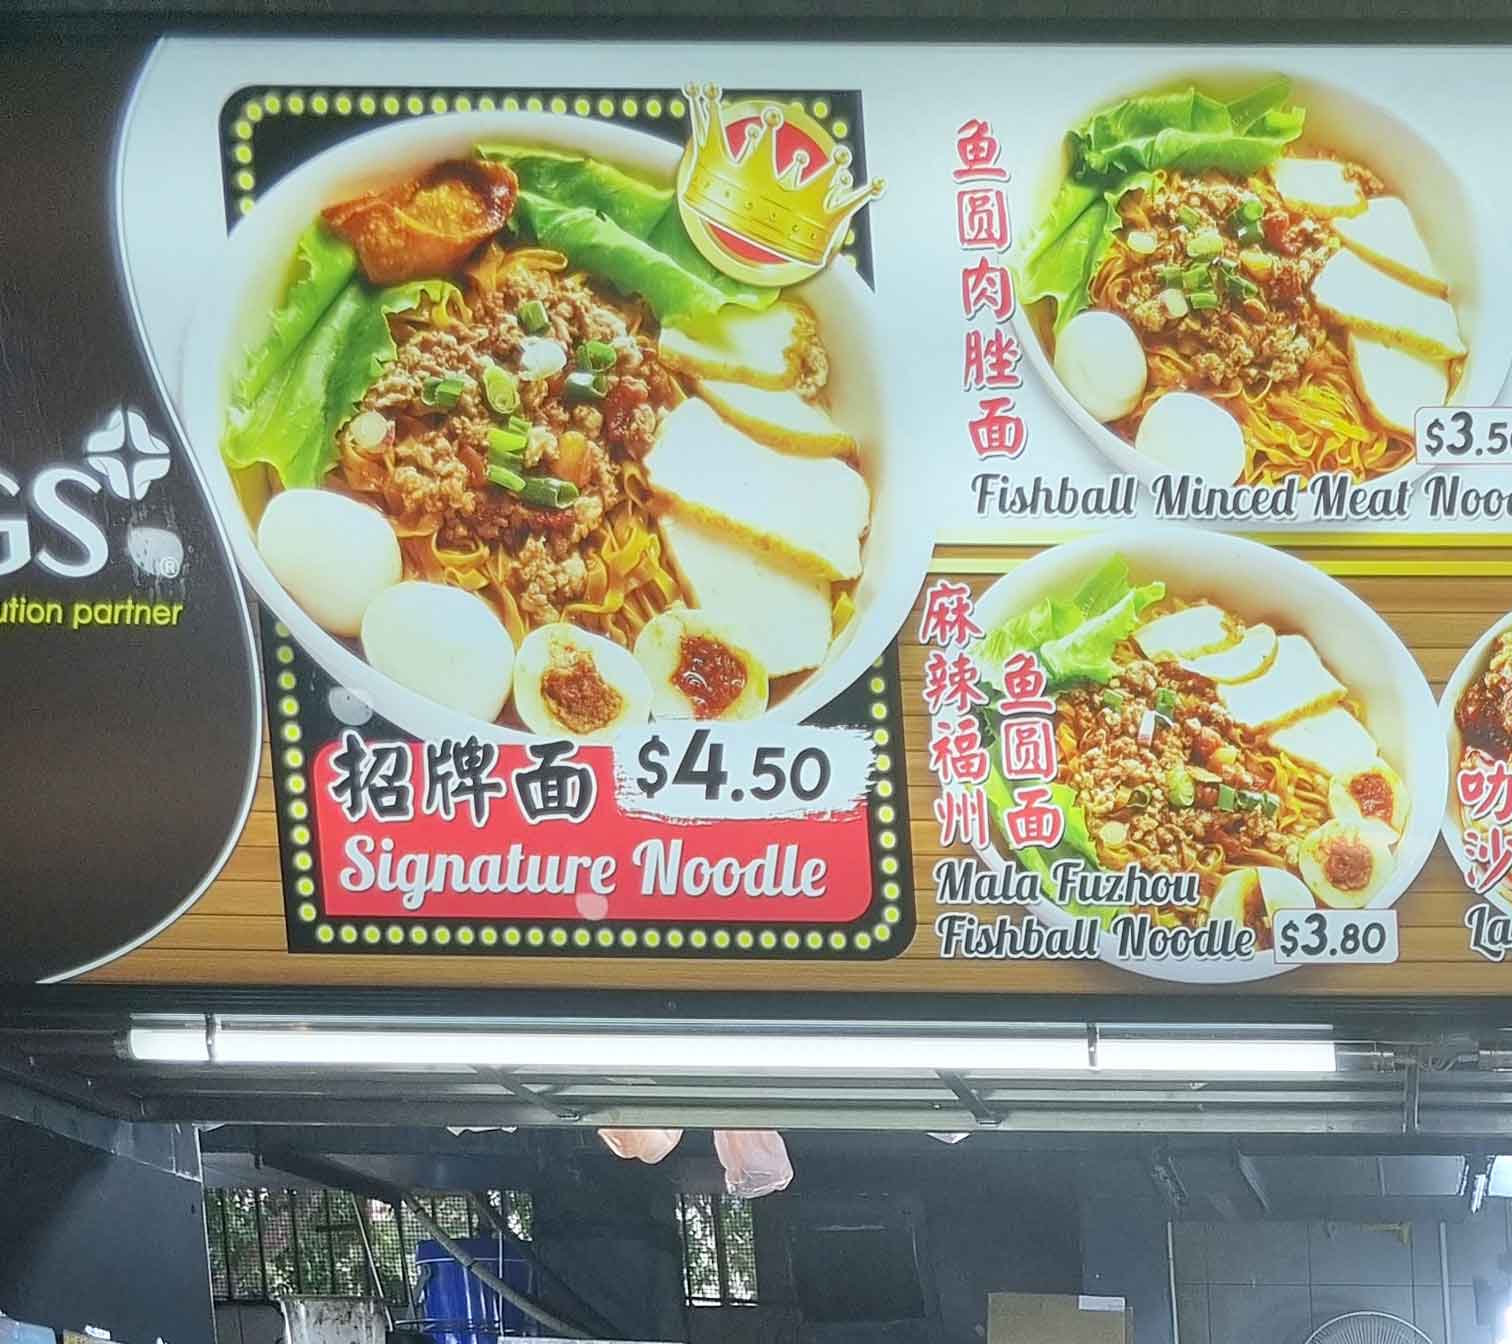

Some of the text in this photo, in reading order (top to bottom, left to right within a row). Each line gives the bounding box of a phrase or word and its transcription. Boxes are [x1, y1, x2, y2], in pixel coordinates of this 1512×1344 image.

[971, 472, 1136, 517] Fishball
[1151, 473, 1297, 518] Minced
[1310, 473, 1413, 518] Meat
[73, 597, 183, 629] partner
[920, 580, 990, 848] 麻辣福州
[330, 730, 594, 824] 招牌面
[637, 729, 831, 801] $4.50
[1000, 651, 1065, 848] 鱼圆面
[339, 833, 827, 910] Signature Noodle
[935, 859, 1200, 905] Mala Fuzhou
[936, 909, 1255, 957] Fishball Noodle
[1281, 914, 1387, 957] $3.80
